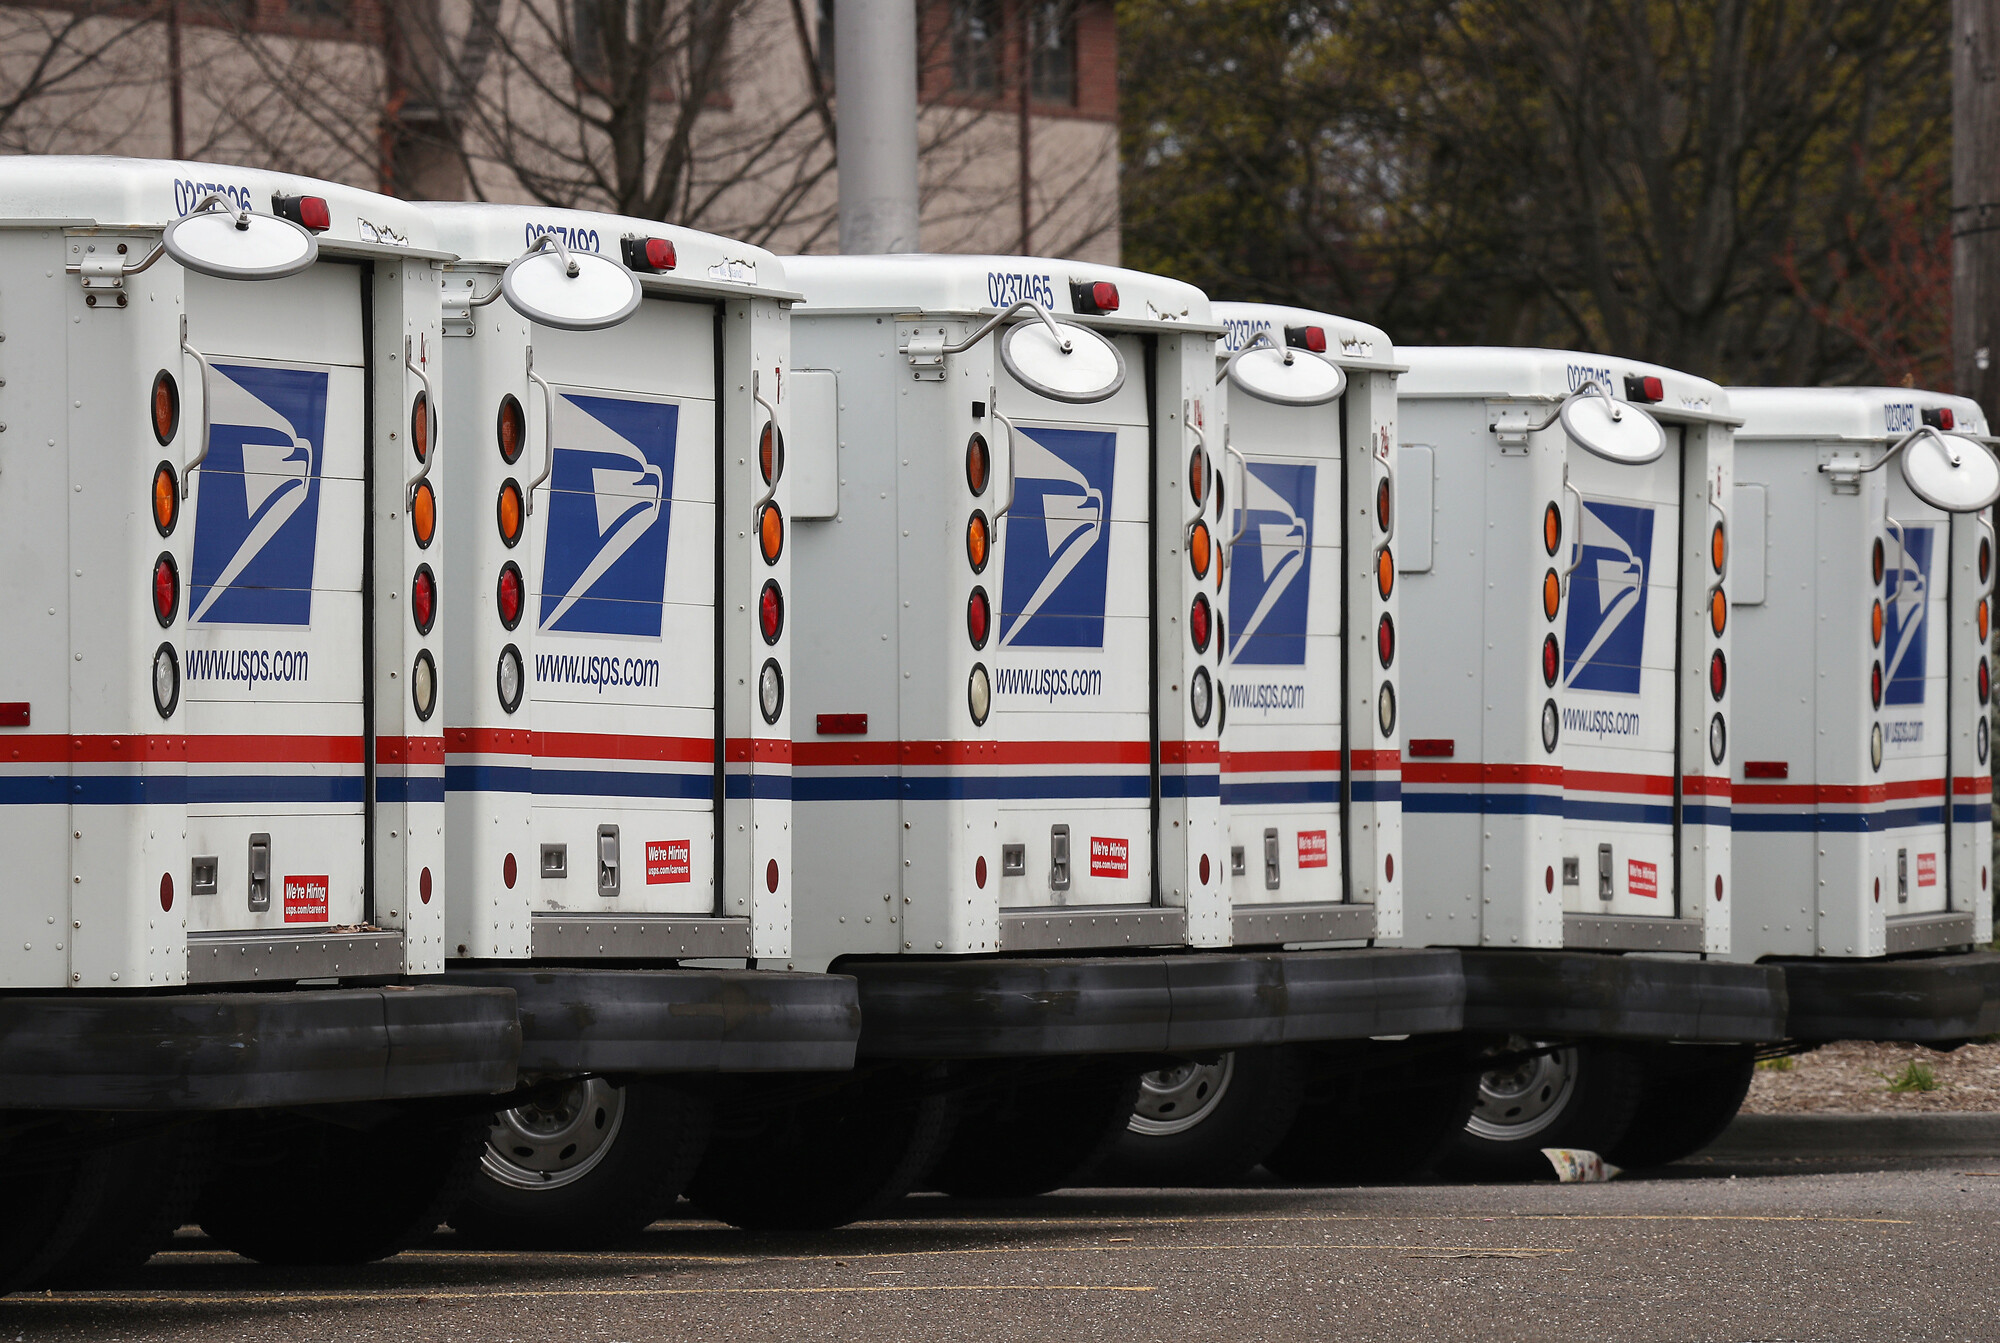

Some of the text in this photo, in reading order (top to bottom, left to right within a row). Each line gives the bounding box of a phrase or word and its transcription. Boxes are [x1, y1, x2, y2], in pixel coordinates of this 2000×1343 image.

[987, 271, 1054, 310] 0237465
[185, 649, 309, 691] www.usps.com
[535, 653, 660, 694] www.usps.com
[995, 668, 1102, 704] www.usps.com
[1228, 684, 1305, 716] ww.usps.com
[648, 845, 688, 863] We're Hiring
[1092, 840, 1127, 861] We're Hiring
[286, 882, 326, 903] We're Hiring
[286, 903, 326, 917] usps.com/careers
